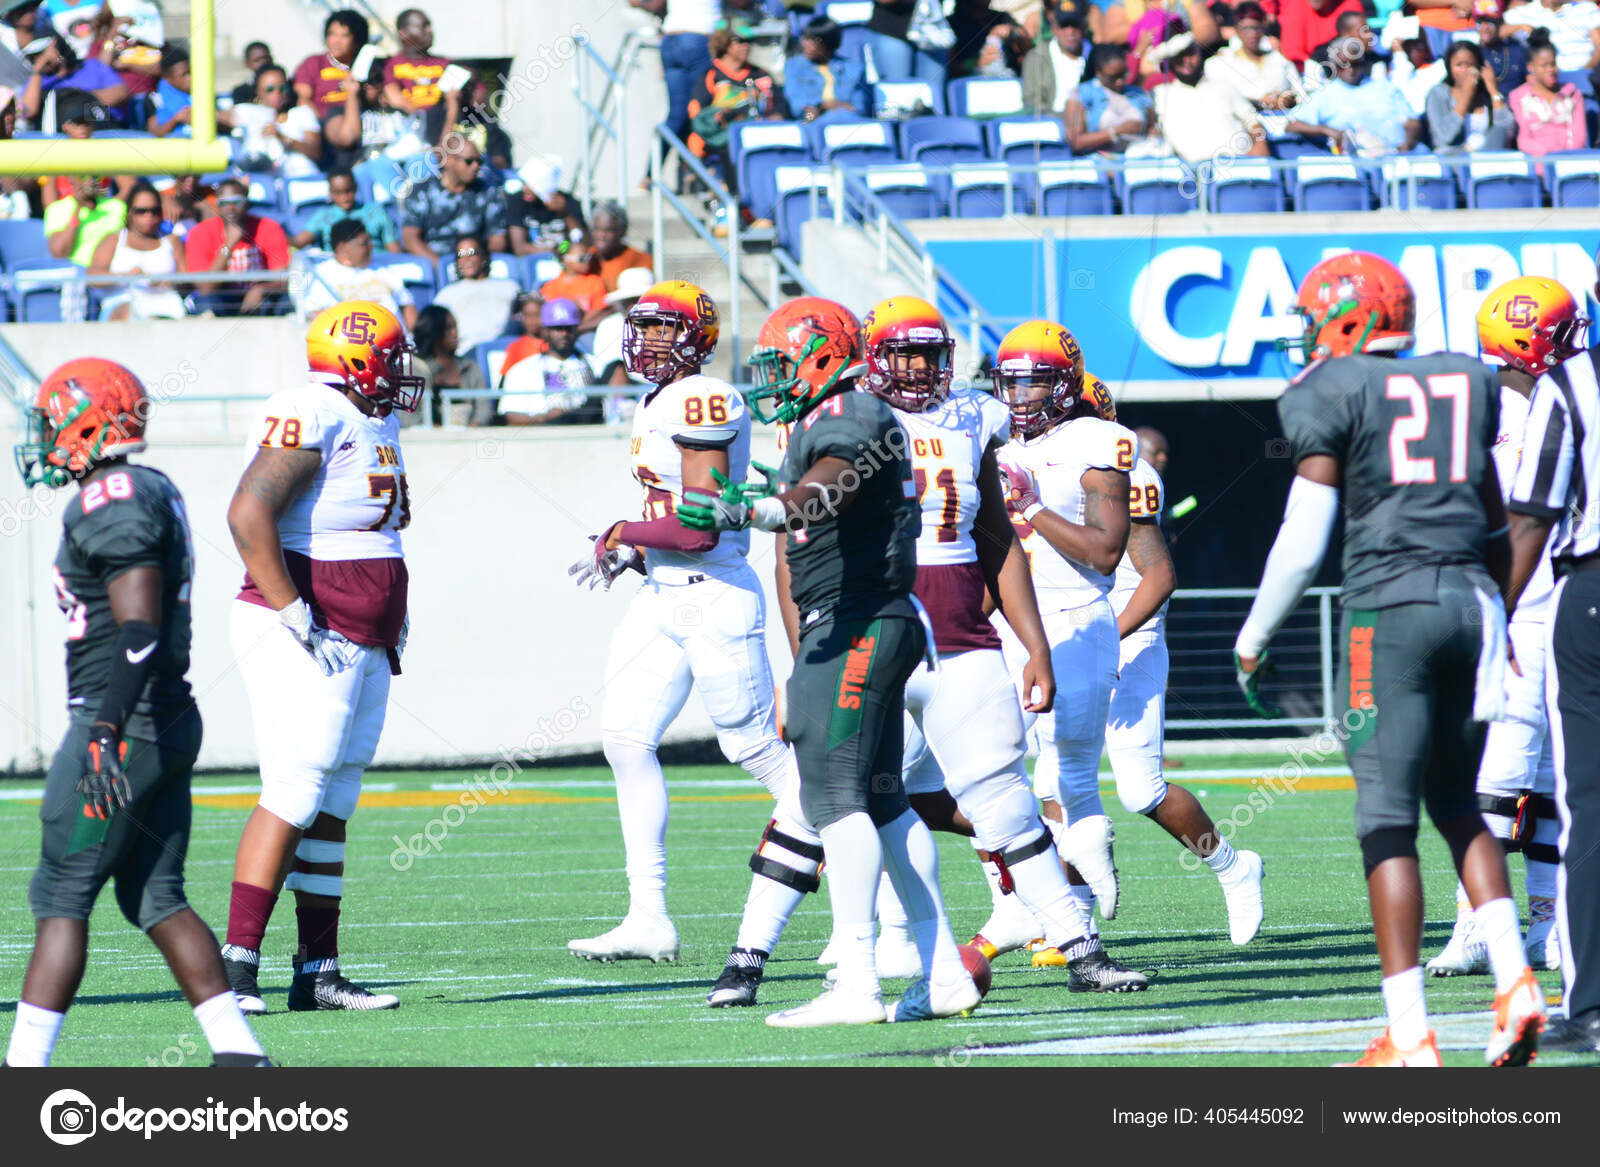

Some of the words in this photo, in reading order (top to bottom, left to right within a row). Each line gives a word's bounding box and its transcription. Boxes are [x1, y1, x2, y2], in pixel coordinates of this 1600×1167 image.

[685, 394, 728, 425] 86
[261, 416, 302, 448] 78
[1386, 372, 1470, 484] 27
[912, 438, 945, 459] CU
[1116, 438, 1134, 470] 2
[81, 471, 134, 515] 28
[1129, 485, 1160, 516] 28
[837, 634, 875, 710] STRIKE
